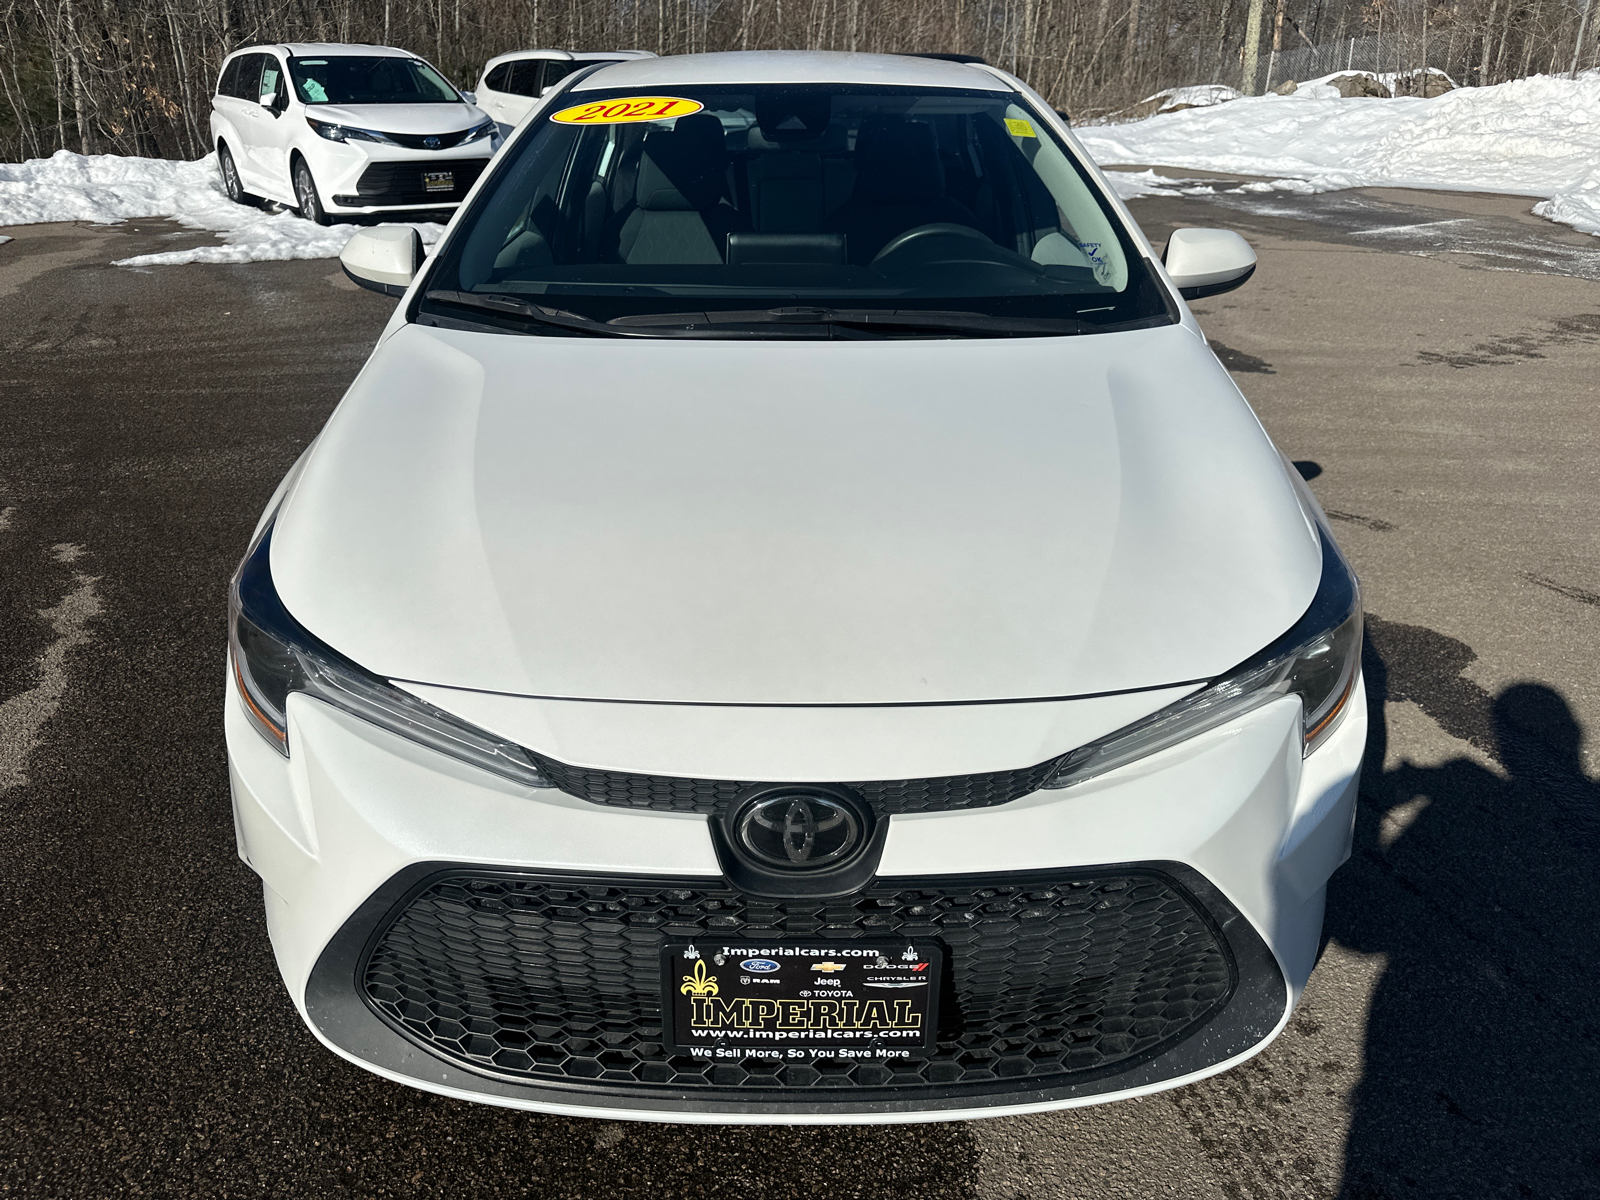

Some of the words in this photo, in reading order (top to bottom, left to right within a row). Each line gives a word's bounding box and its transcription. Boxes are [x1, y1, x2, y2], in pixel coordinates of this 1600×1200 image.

[573, 101, 680, 121] 2021
[722, 946, 880, 958] Imperialcars.com
[749, 961, 772, 970] Ford
[814, 977, 841, 987] Jeep
[691, 997, 922, 1029] IMPERIAL
[691, 1029, 921, 1040] www.imperialcars.com
[690, 1047, 712, 1057] We
[715, 1048, 741, 1057] Sell
[745, 1048, 783, 1060] More,
[787, 1048, 805, 1058] So
[808, 1048, 835, 1058] You
[838, 1048, 872, 1058] Save
[875, 1048, 910, 1058] More
